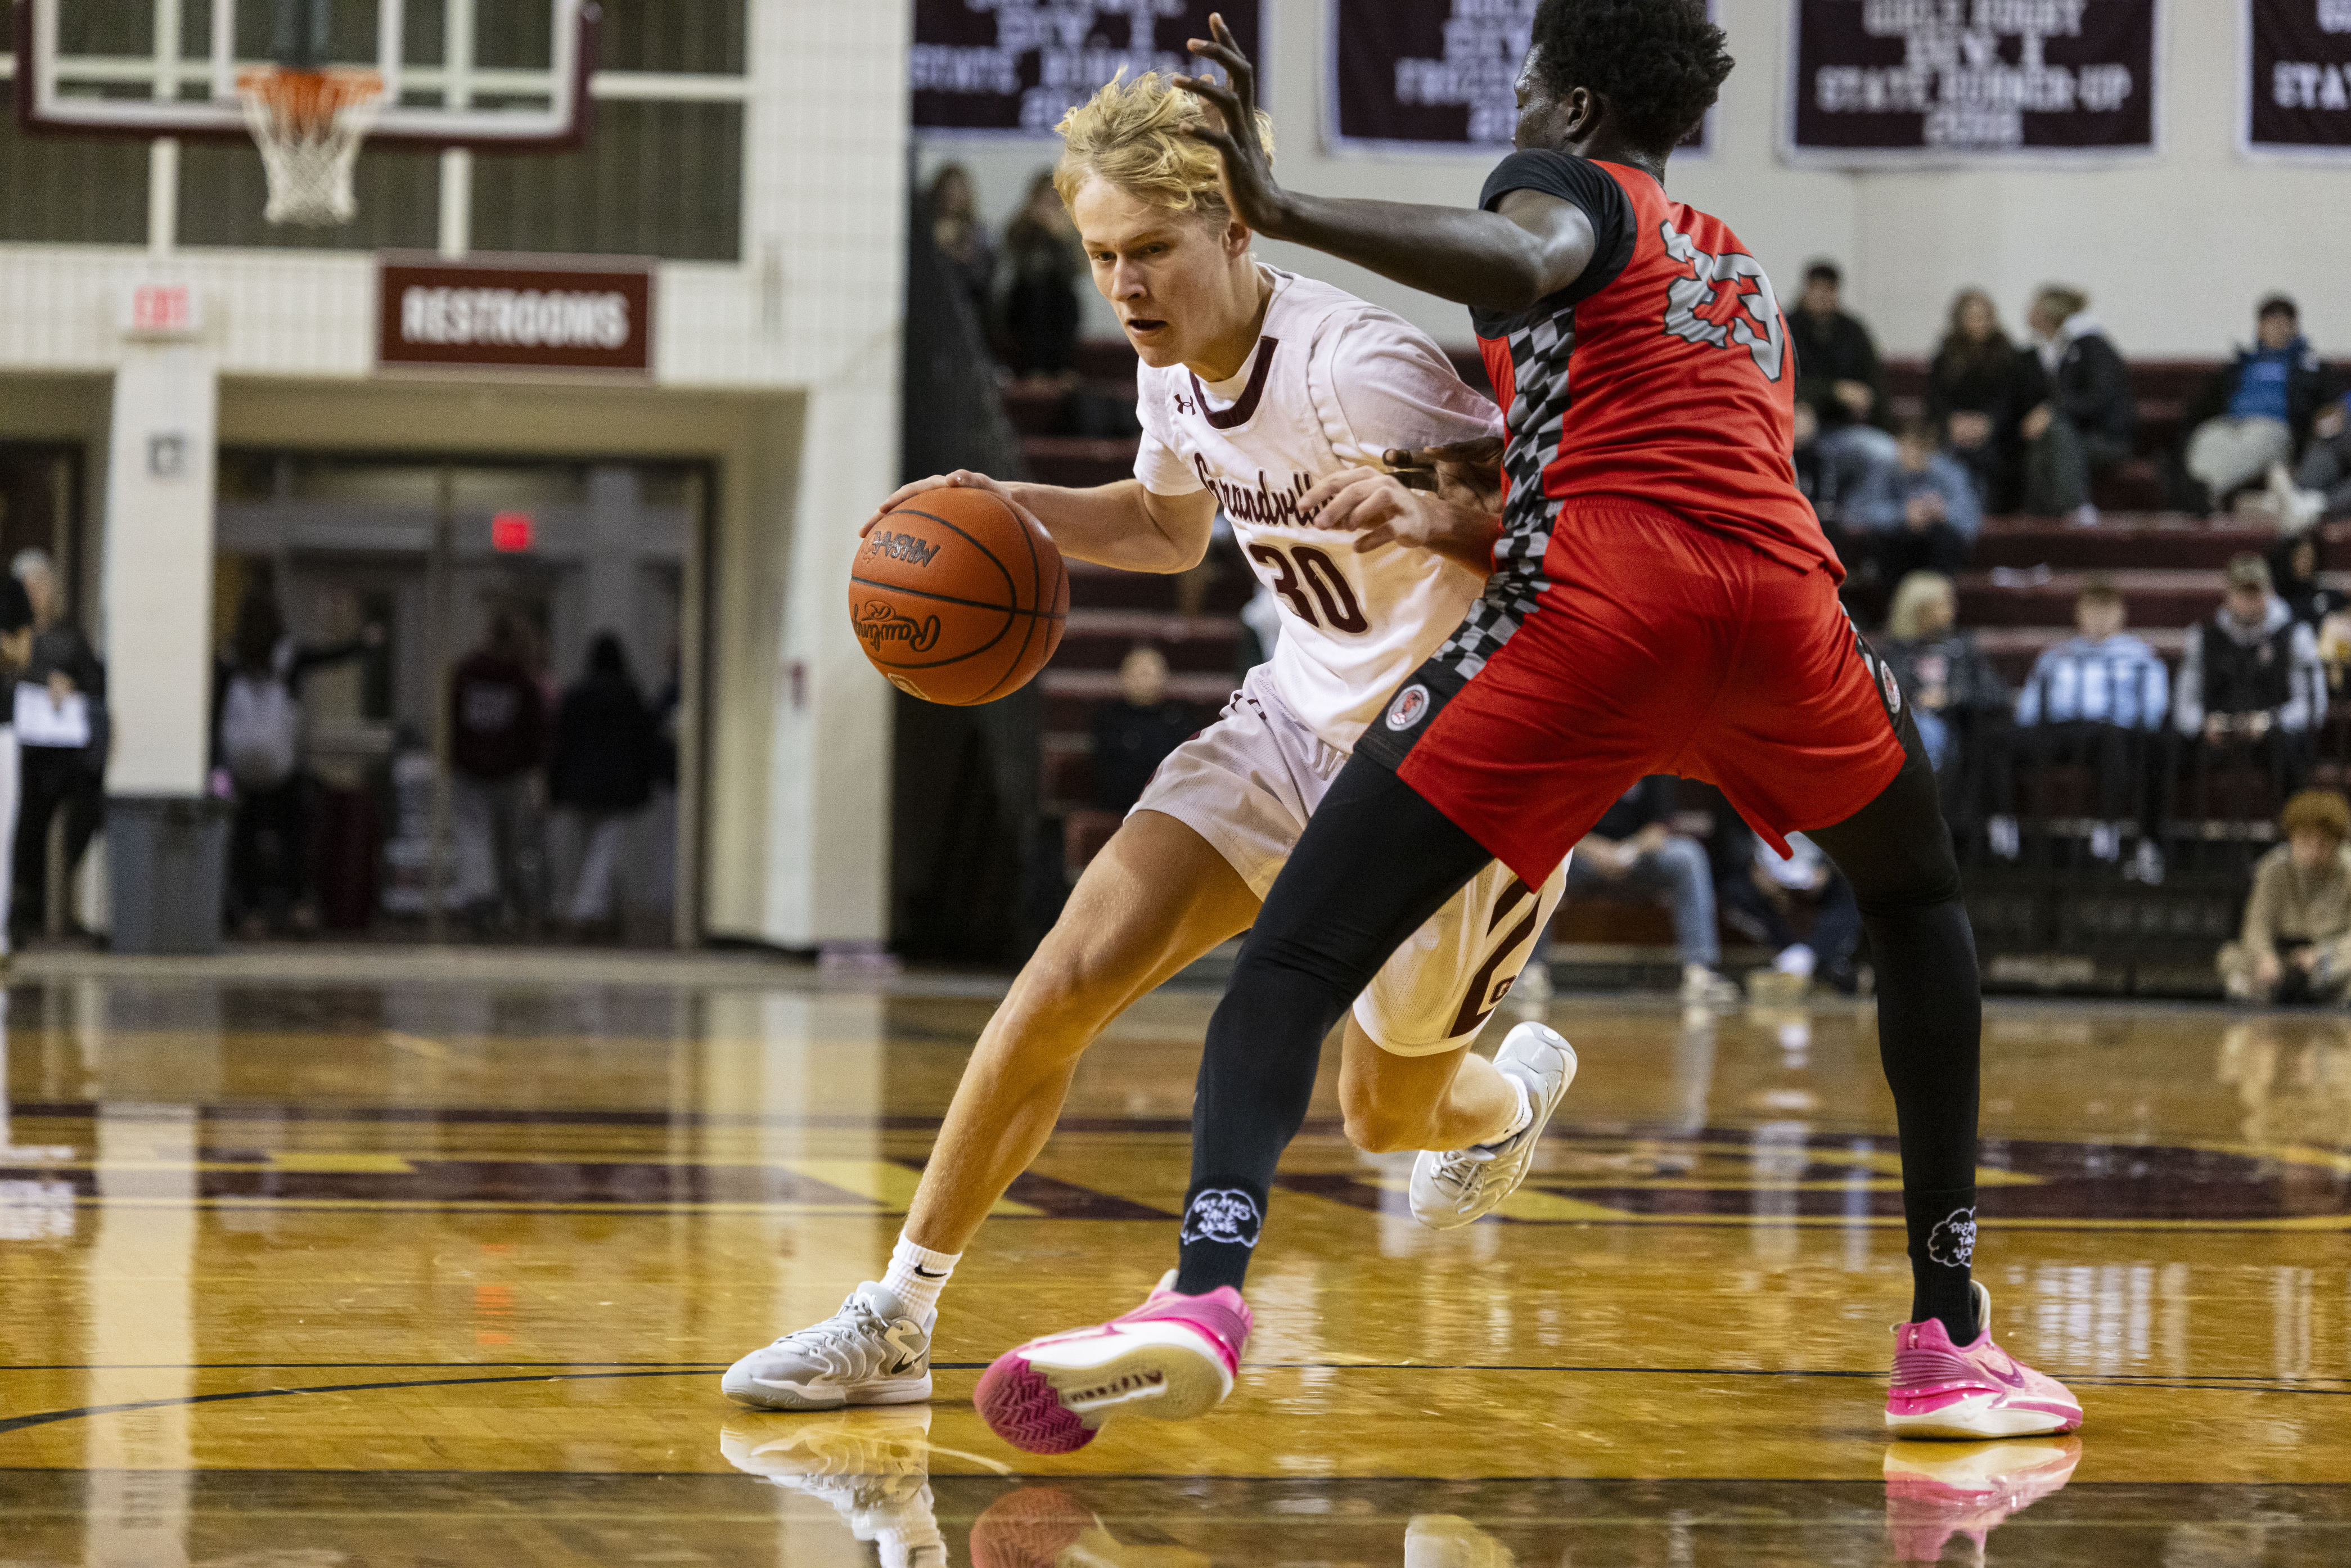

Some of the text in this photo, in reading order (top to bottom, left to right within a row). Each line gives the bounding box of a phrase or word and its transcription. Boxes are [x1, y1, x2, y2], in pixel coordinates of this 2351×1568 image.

[1815, 65, 1933, 111] STATE
[2273, 61, 2351, 110] STA
[402, 285, 629, 349] RESTROOMS
[1659, 219, 1785, 384] 23
[1246, 543, 1370, 636] 30
[853, 603, 942, 652] Rawling
